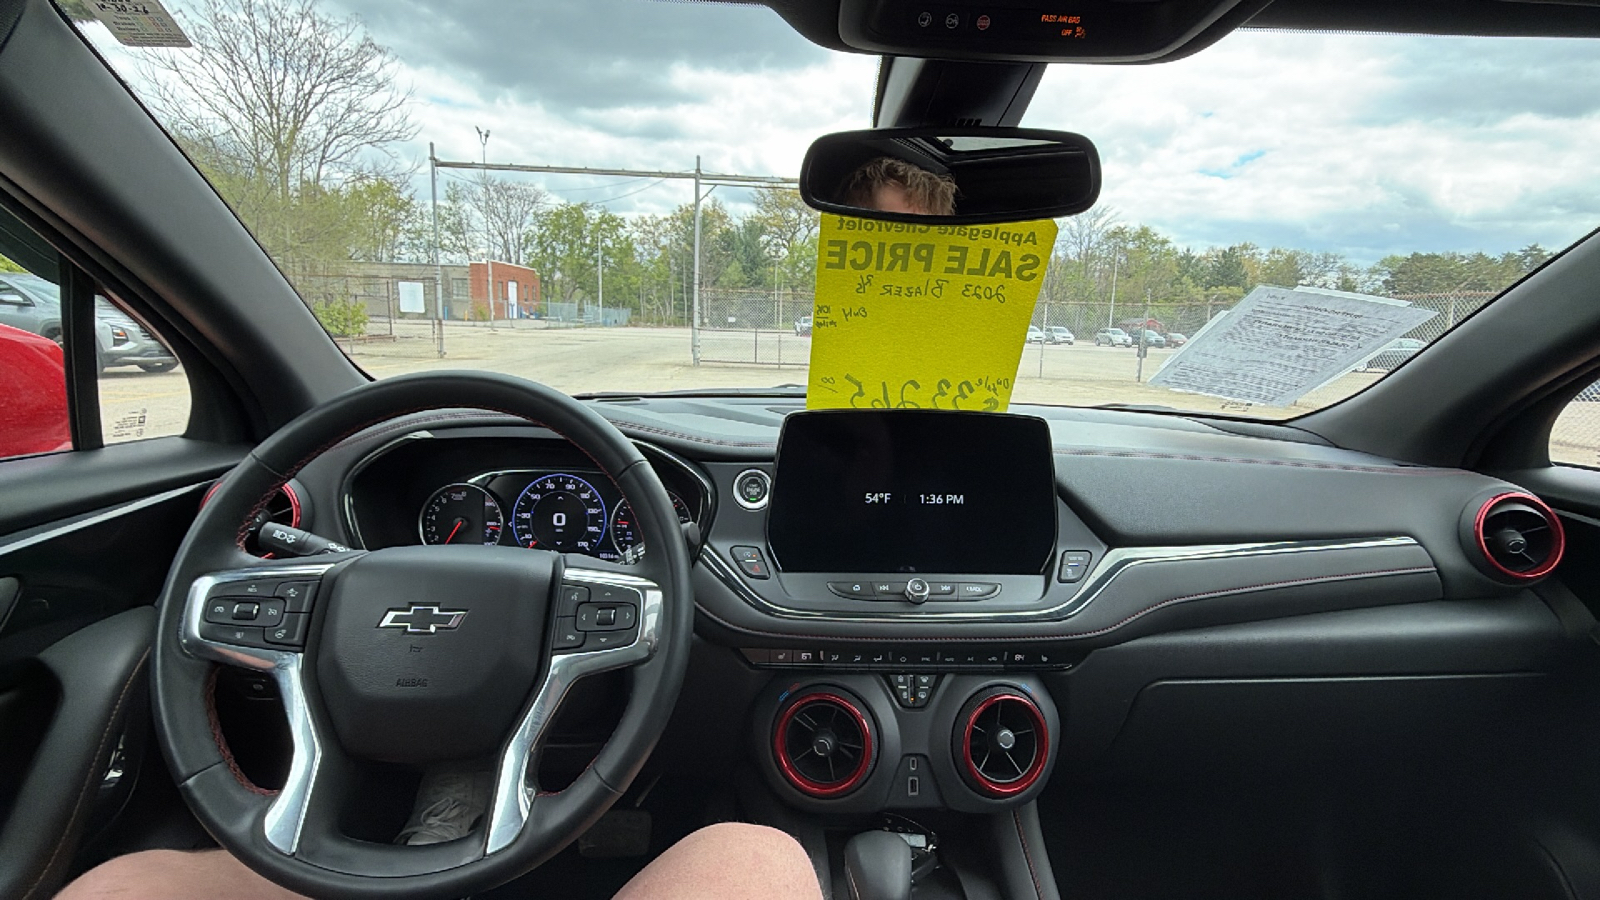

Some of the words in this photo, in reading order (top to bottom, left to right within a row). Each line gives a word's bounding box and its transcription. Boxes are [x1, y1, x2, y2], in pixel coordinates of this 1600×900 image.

[1041, 14, 1057, 22] PASS
[1057, 15, 1068, 23] AIR
[1068, 16, 1080, 24] BAG
[865, 492, 892, 504] 54°F
[919, 494, 943, 504] 1:36
[946, 494, 964, 504] PM
[552, 512, 567, 527] 0
